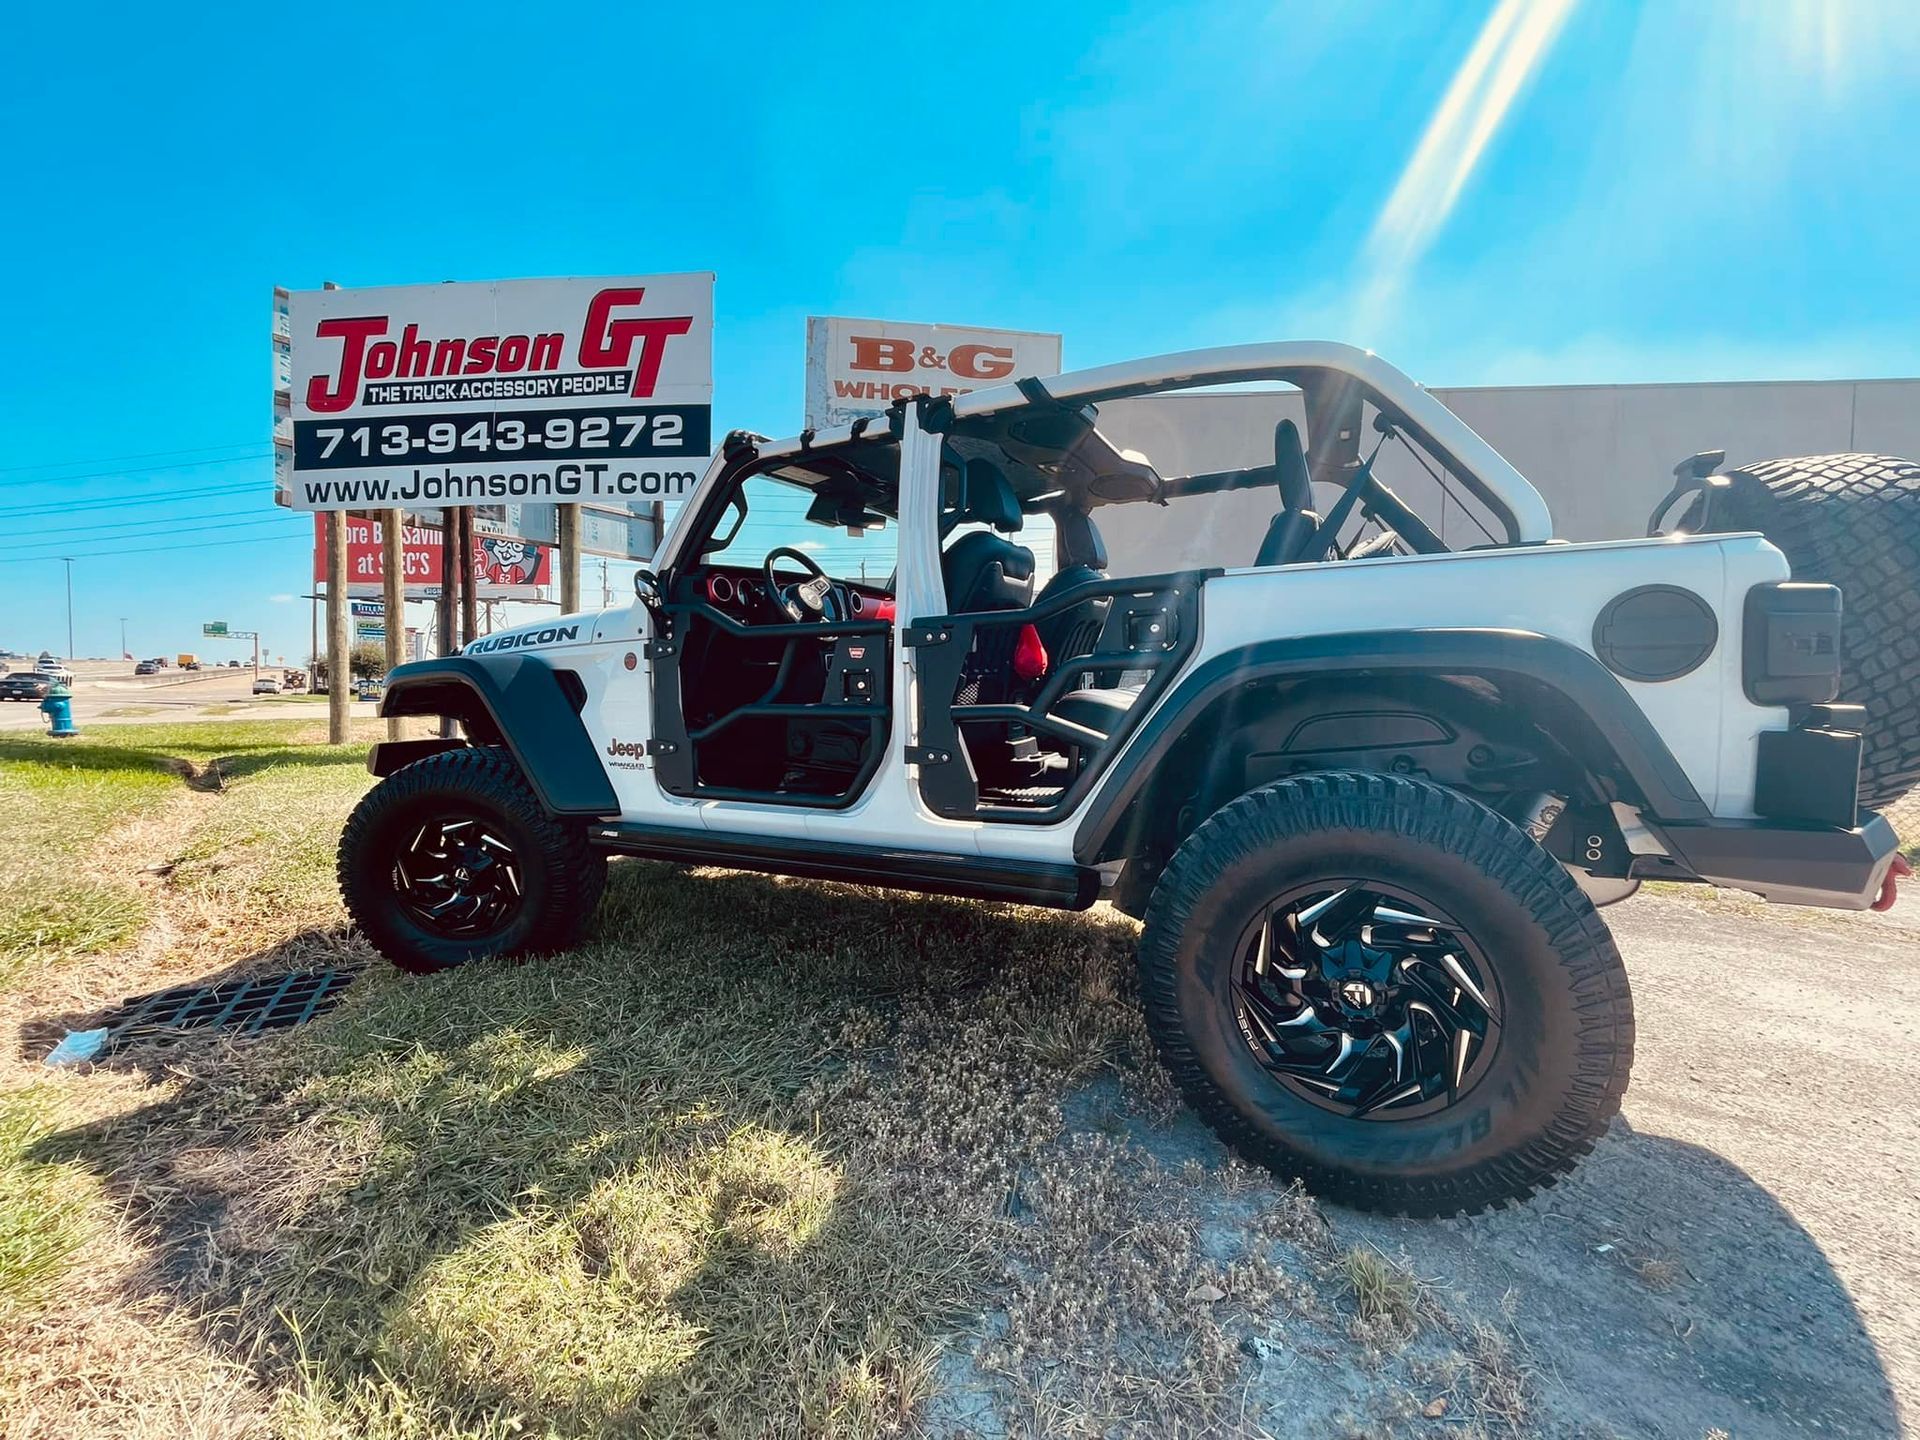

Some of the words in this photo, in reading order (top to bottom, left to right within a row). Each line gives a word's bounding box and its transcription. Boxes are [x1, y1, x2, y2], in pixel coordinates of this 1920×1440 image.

[306, 316, 564, 413] Johnson
[579, 287, 693, 399] GT
[850, 336, 1016, 380] B&G
[369, 386, 400, 403] THE
[402, 383, 456, 401] TRUCK
[459, 377, 561, 399] ACCESSORY
[562, 374, 625, 394] PEOPLE
[315, 413, 684, 460] 713-943-9272
[304, 464, 697, 504] www.JohnsonGT.com
[357, 553, 374, 575] at
[499, 574, 511, 584] 62
[468, 625, 580, 655] RUBICON
[606, 738, 645, 760] Jeep
[1237, 1008, 1259, 1051] FUEL
